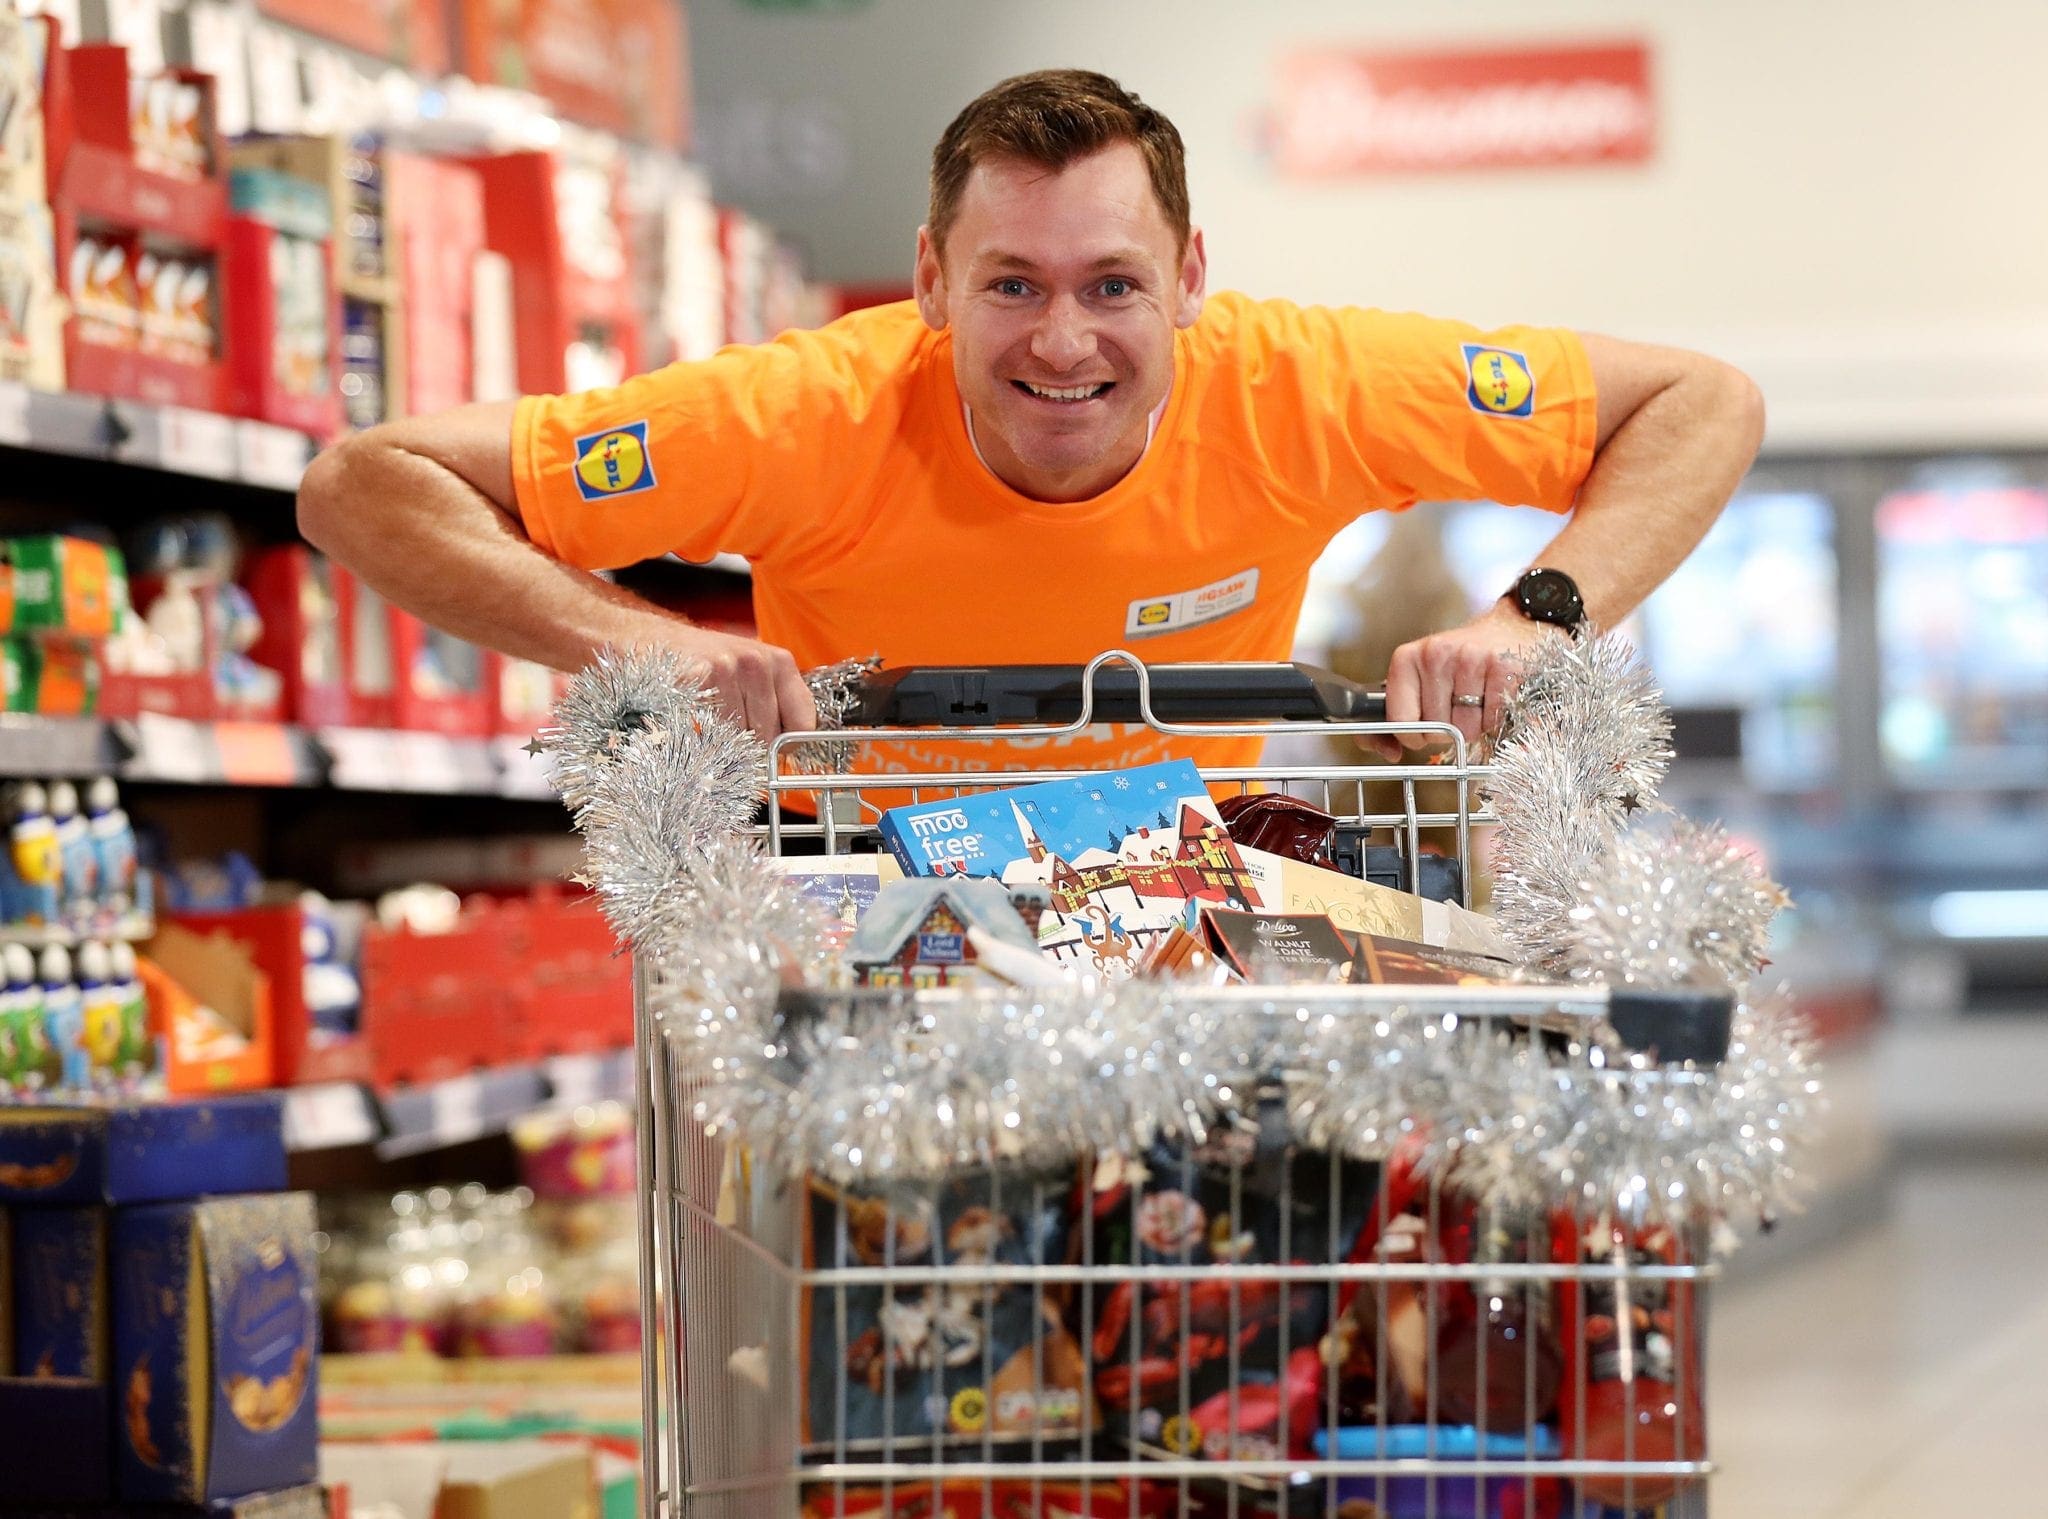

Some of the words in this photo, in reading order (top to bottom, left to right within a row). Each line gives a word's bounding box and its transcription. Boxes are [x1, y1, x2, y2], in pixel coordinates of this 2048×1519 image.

[909, 811, 969, 838] moo
[1256, 919, 1298, 934] Deluxe
[1258, 938, 1311, 949] WALNUT
[1280, 948, 1315, 957] DATE
